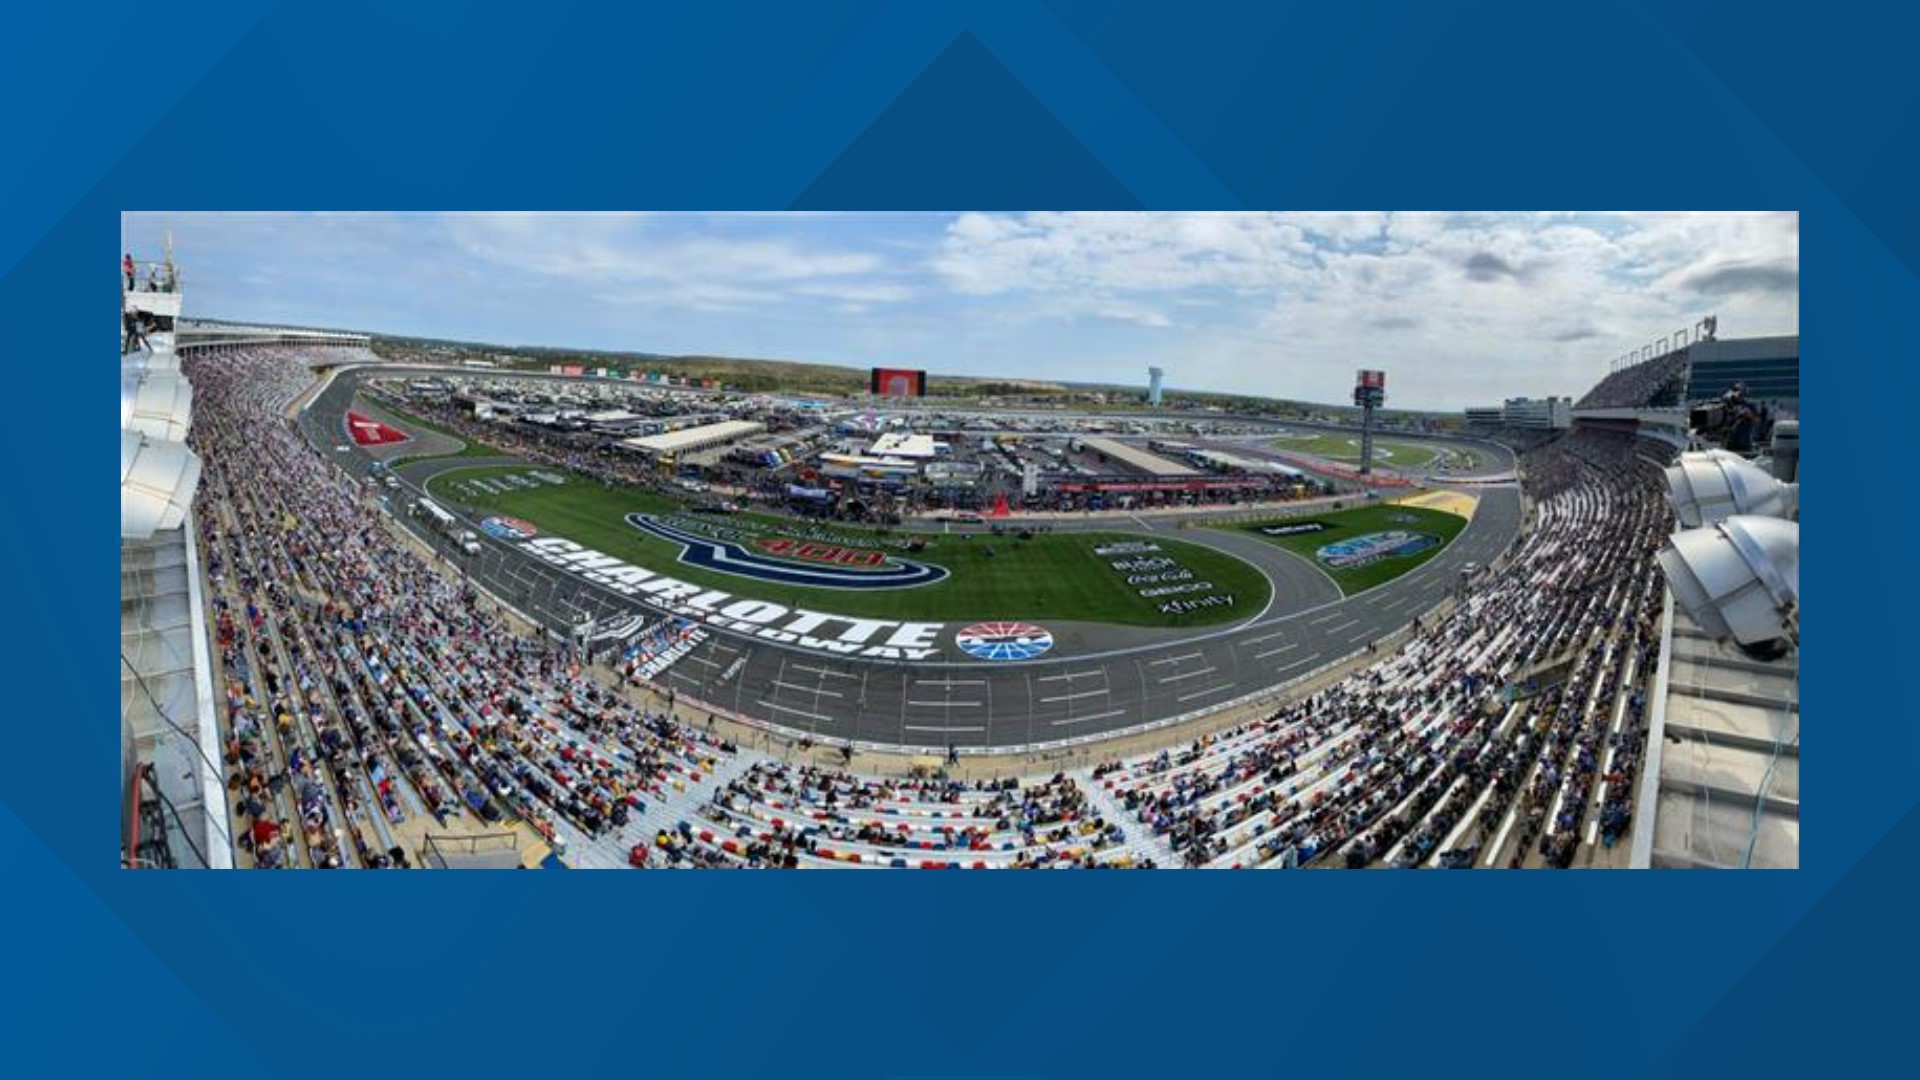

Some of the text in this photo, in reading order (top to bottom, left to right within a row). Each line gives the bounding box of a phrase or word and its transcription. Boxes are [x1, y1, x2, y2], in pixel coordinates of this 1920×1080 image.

[753, 538, 887, 568] 400
[530, 537, 946, 648] CHARLOTTE
[644, 597, 940, 660] SPEEDWAY
